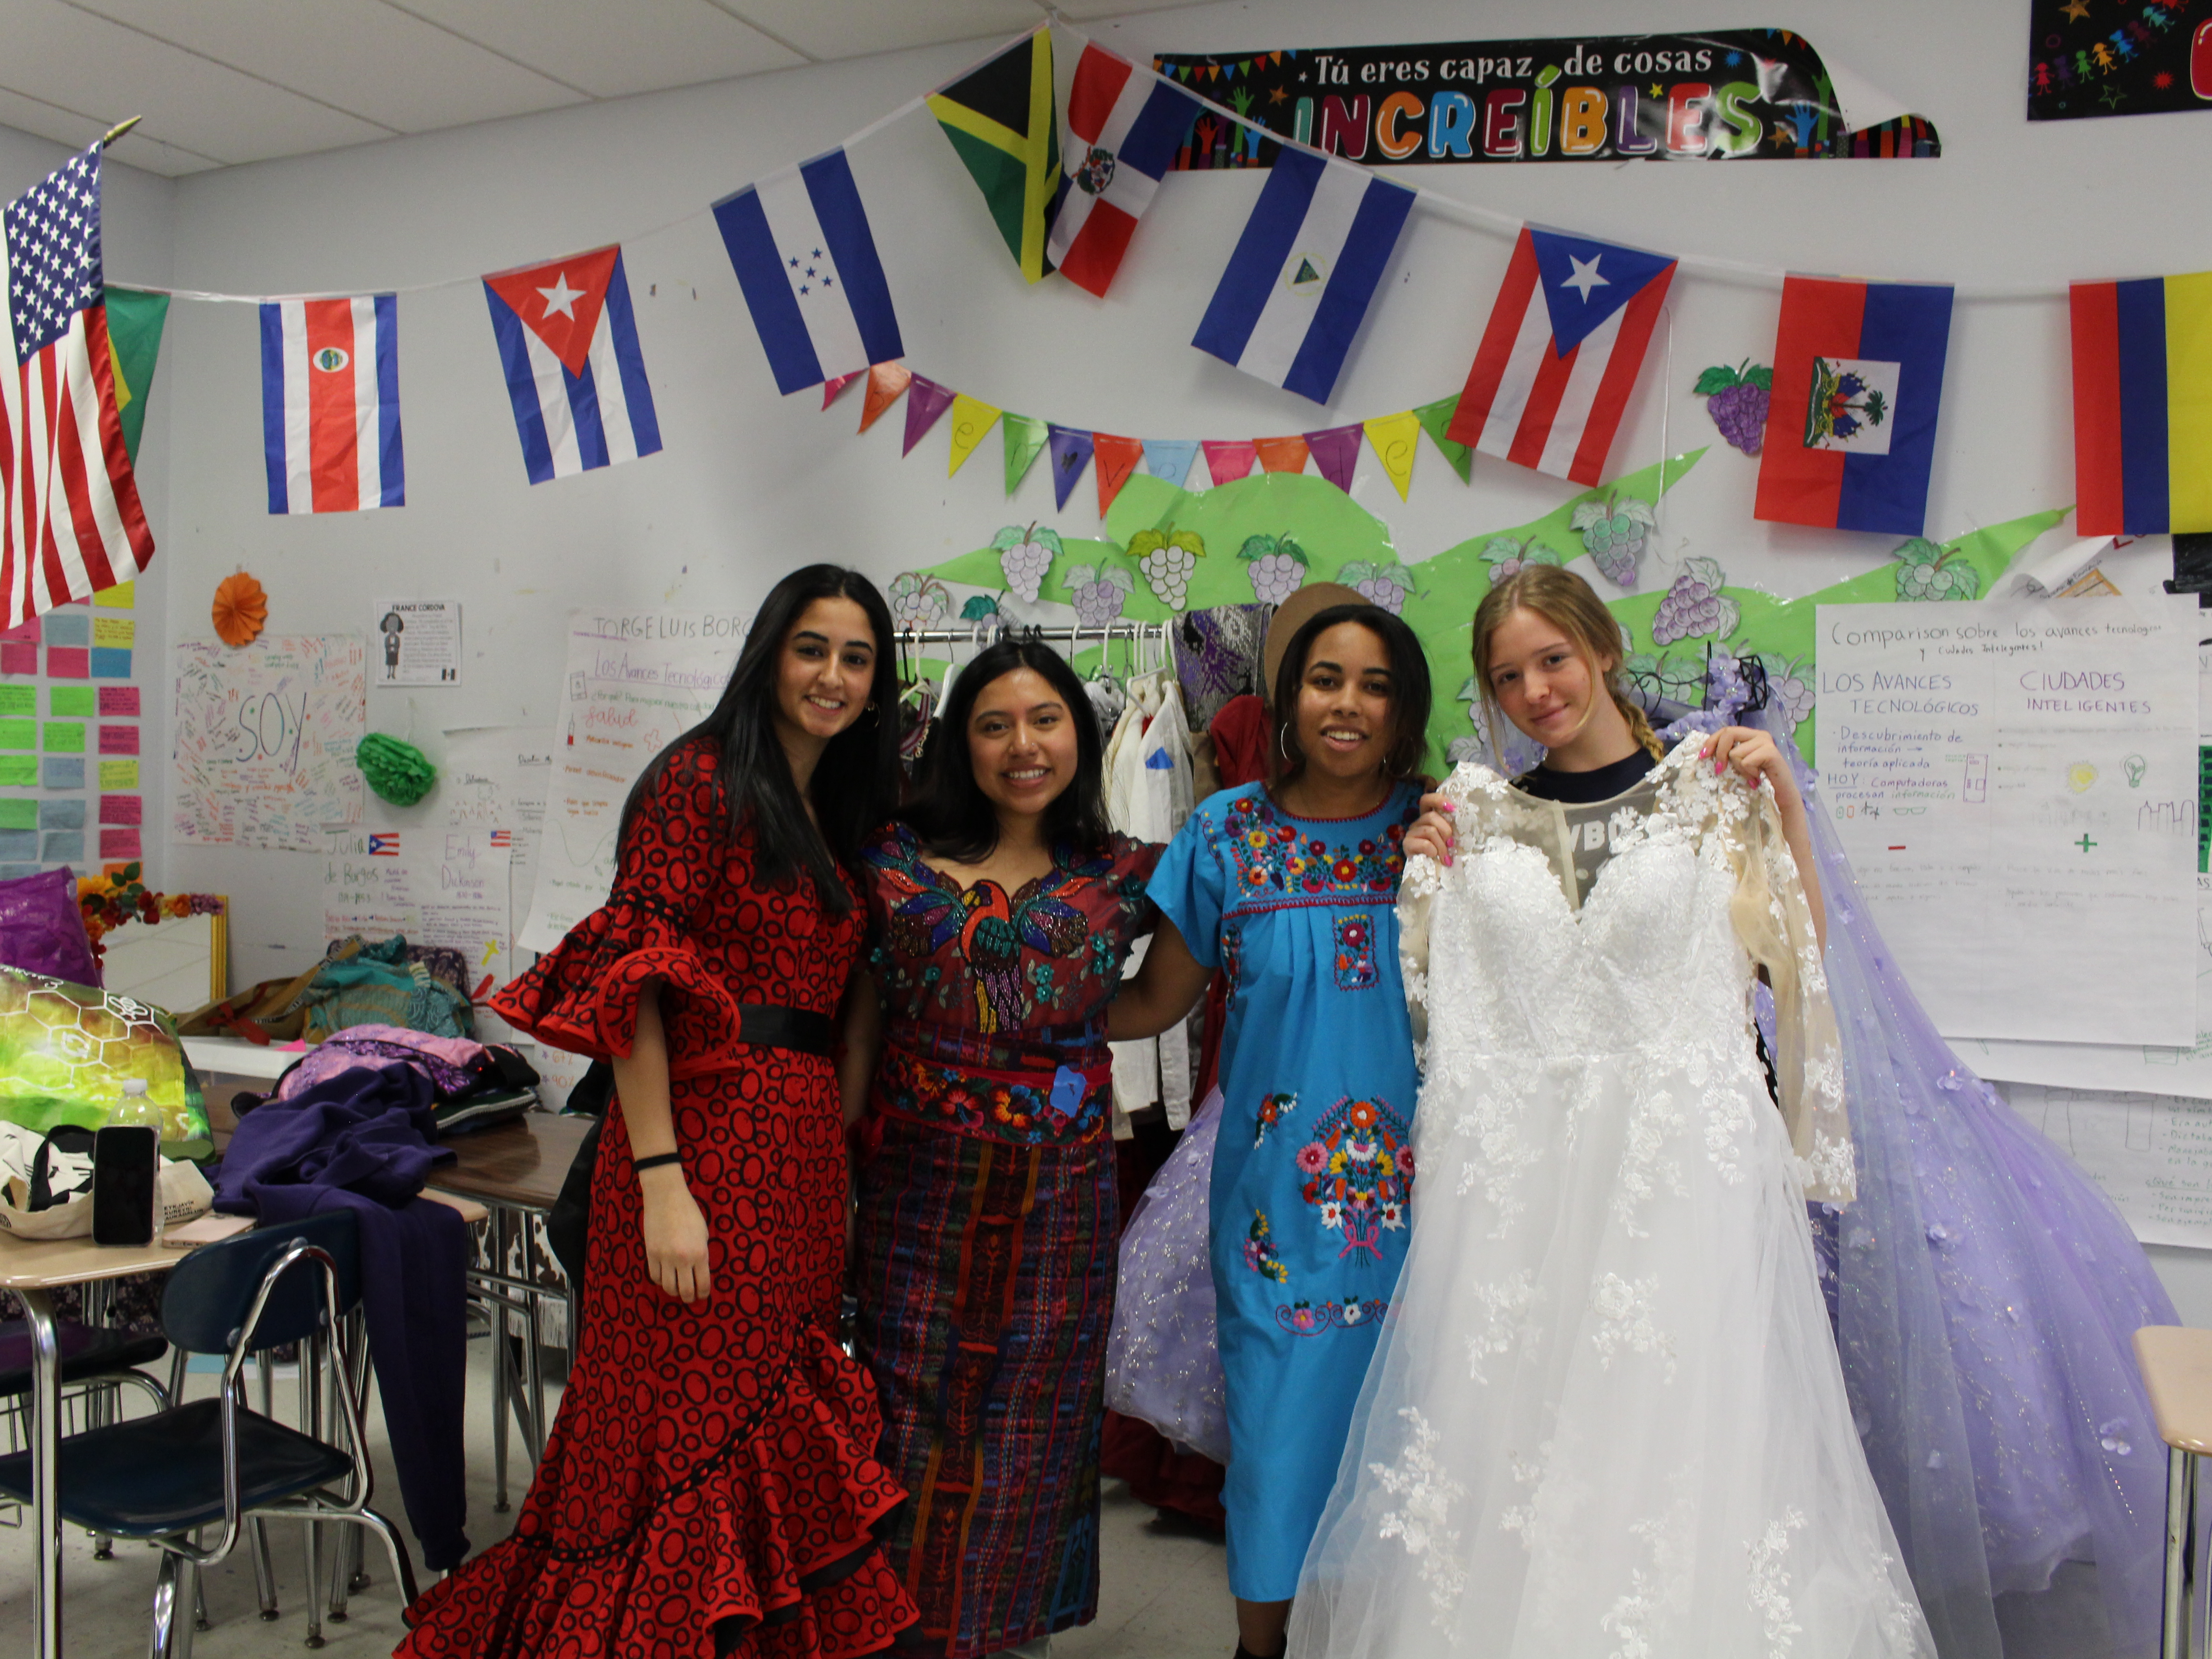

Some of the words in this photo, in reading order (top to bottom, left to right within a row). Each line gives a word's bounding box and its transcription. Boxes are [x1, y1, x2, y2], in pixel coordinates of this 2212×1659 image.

[1315, 55, 1349, 85] Tú
[1360, 58, 1430, 83] eres
[1439, 55, 1532, 85] capaz
[1563, 45, 1602, 76] de
[1612, 48, 1712, 75] cosas
[1293, 63, 1763, 159] INCREÍBLES
[392, 604, 417, 612] FRANCE
[660, 615, 696, 639] LUIS
[1832, 622, 1949, 649] Comparison
[1956, 623, 1999, 640] sobre
[2016, 622, 2036, 638] los
[2045, 625, 2098, 639] avances
[1823, 671, 1864, 694] LOS
[1872, 670, 1952, 691] AVANCES
[2020, 671, 2125, 691] CIUDADES
[1850, 698, 1979, 716] TECNOLÓGICOS
[2027, 697, 2151, 714] INTELIGENTES
[236, 691, 307, 771] SOY
[1840, 725, 1942, 743] Descubrimiento
[1947, 729, 1963, 744] de
[1837, 743, 1902, 755] información
[1843, 754, 1879, 769] teoría
[1882, 756, 1930, 772] aplicada
[1836, 789, 1885, 803] procesan
[1891, 788, 1956, 801] información
[327, 832, 366, 855] Julia
[445, 834, 481, 869] Emily
[325, 862, 337, 885] de
[344, 863, 379, 888] Burgos
[442, 864, 484, 890] Dickinson
